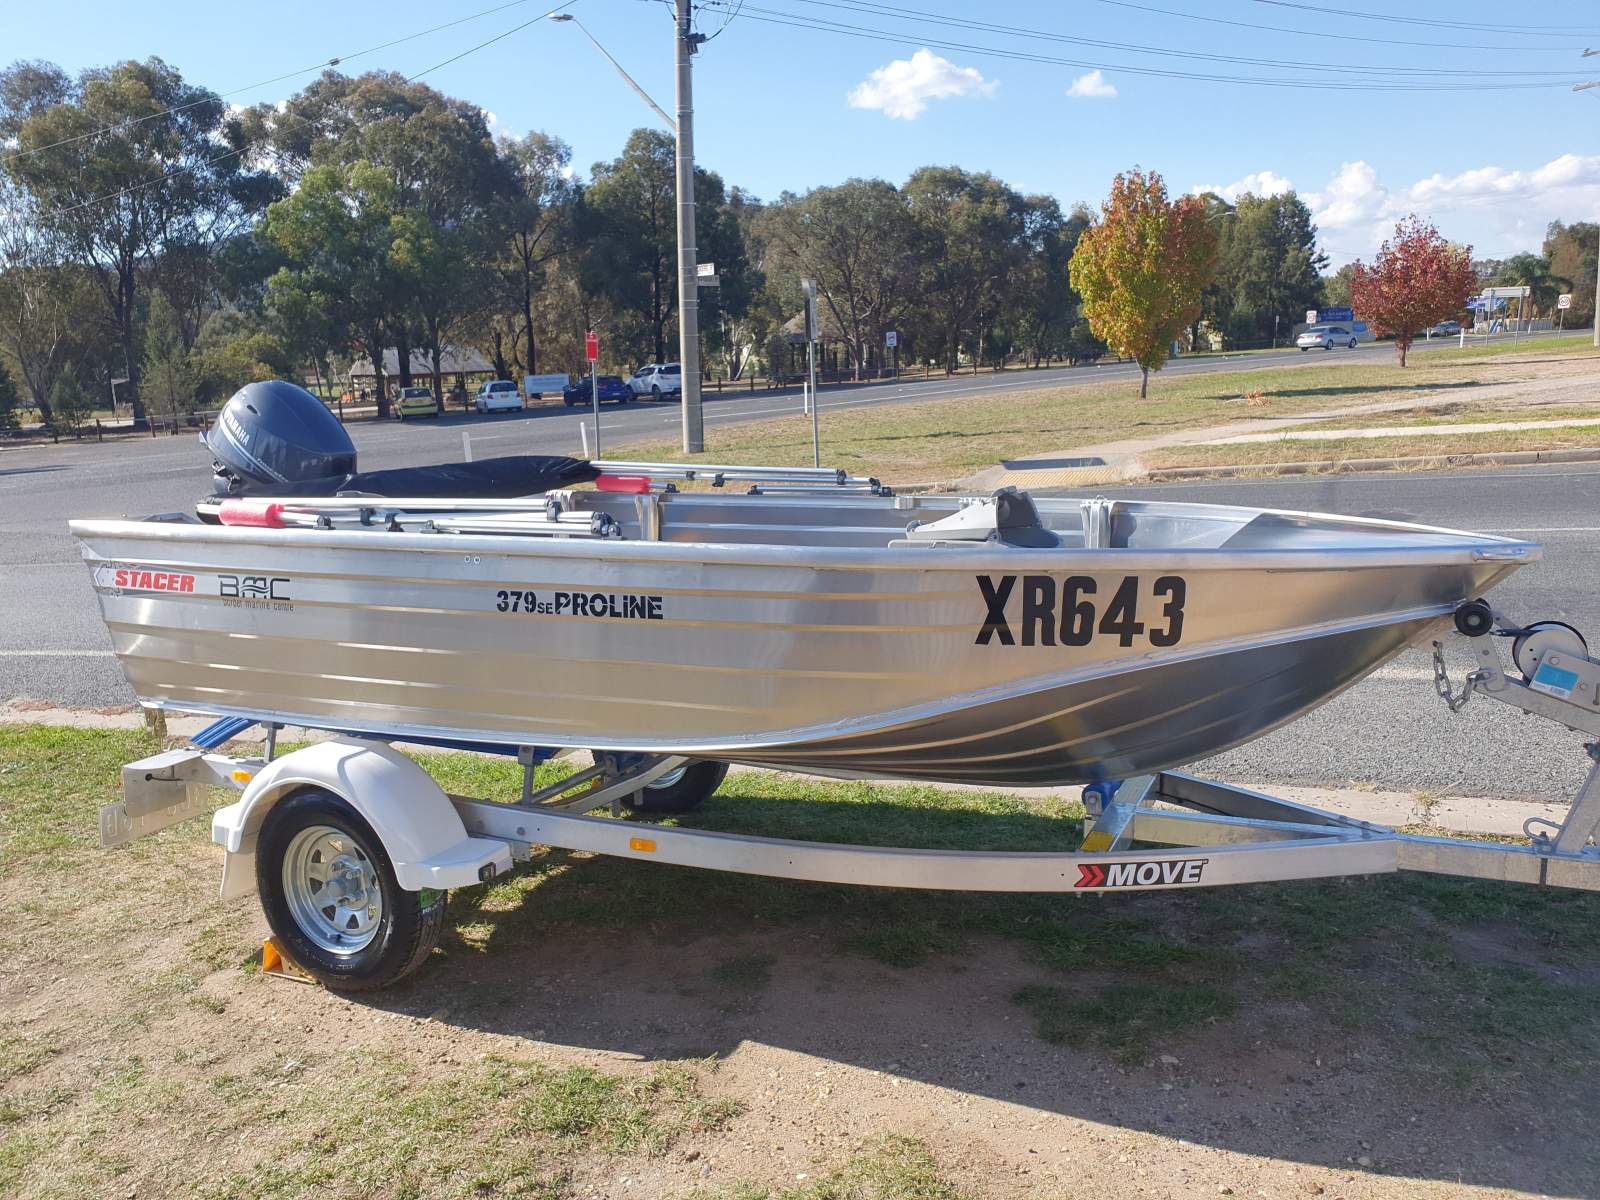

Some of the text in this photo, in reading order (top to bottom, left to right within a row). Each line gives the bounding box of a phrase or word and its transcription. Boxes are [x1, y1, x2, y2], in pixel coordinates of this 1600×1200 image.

[224, 406, 250, 446] YAMAHA
[115, 570, 195, 593] STACER
[555, 592, 664, 620] PROLINE
[975, 575, 1187, 647] XR643
[1106, 861, 1203, 886] MOVE
